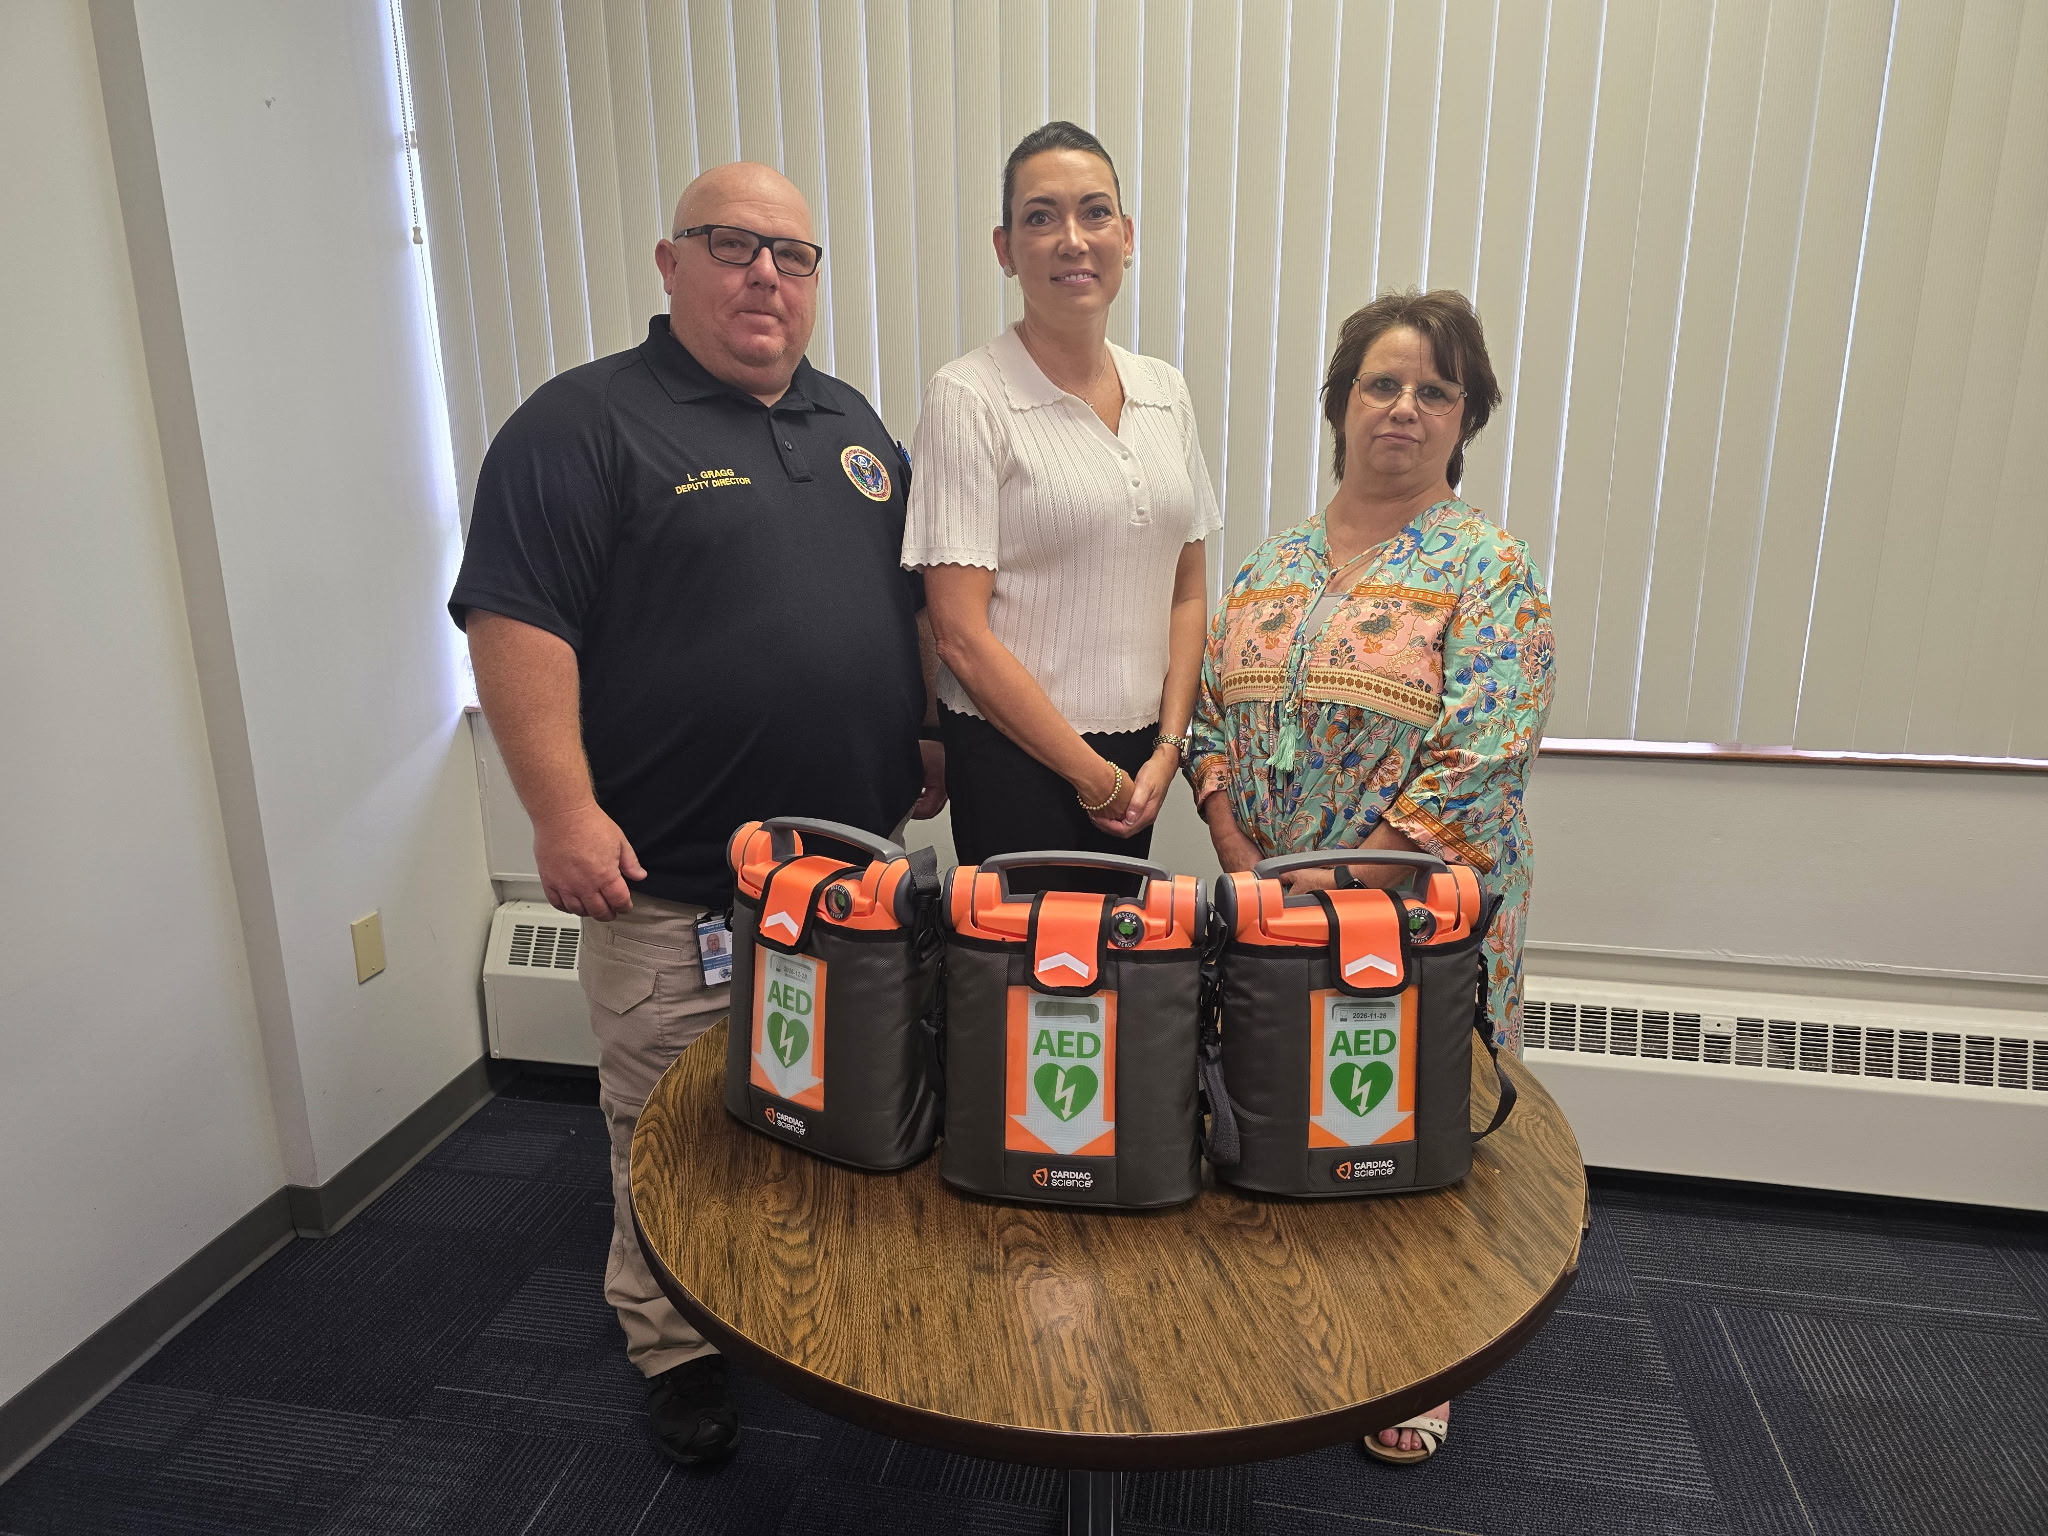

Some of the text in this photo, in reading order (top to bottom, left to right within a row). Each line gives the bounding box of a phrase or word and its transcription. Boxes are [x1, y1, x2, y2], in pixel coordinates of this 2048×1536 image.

[687, 469, 735, 482] L. GRAGG
[674, 477, 752, 495] DEPUTY DIRECTOR
[1114, 912, 1137, 921] RESCUE
[1407, 909, 1429, 918] RESCUE
[1117, 941, 1137, 949] READY
[767, 979, 813, 1016] AED
[1032, 1029, 1102, 1059] AED
[1329, 1028, 1397, 1057] AED
[776, 1111, 804, 1128] CARDIAC
[1353, 1159, 1394, 1170] CARDIAC
[1050, 1170, 1091, 1180] CARDIAC
